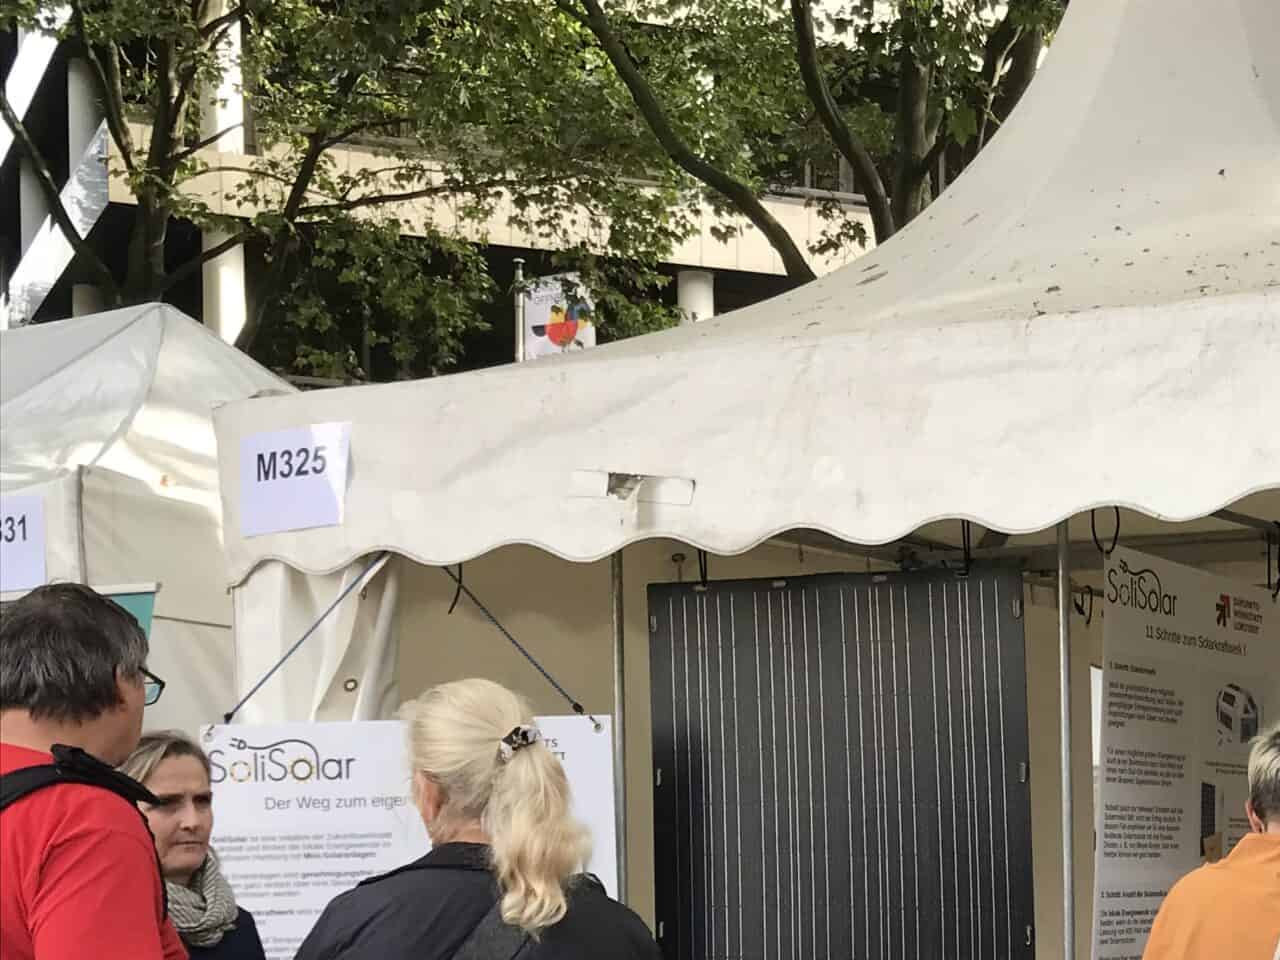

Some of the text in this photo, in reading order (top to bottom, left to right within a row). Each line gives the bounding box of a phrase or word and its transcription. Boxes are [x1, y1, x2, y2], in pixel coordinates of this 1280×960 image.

[257, 446, 326, 482] M325
[0, 514, 27, 542] 31
[1106, 567, 1177, 616] SoliSolar
[208, 748, 356, 784] SoliSolar
[265, 797, 291, 810] Der
[296, 796, 331, 811] Weg
[335, 798, 367, 809] zum
